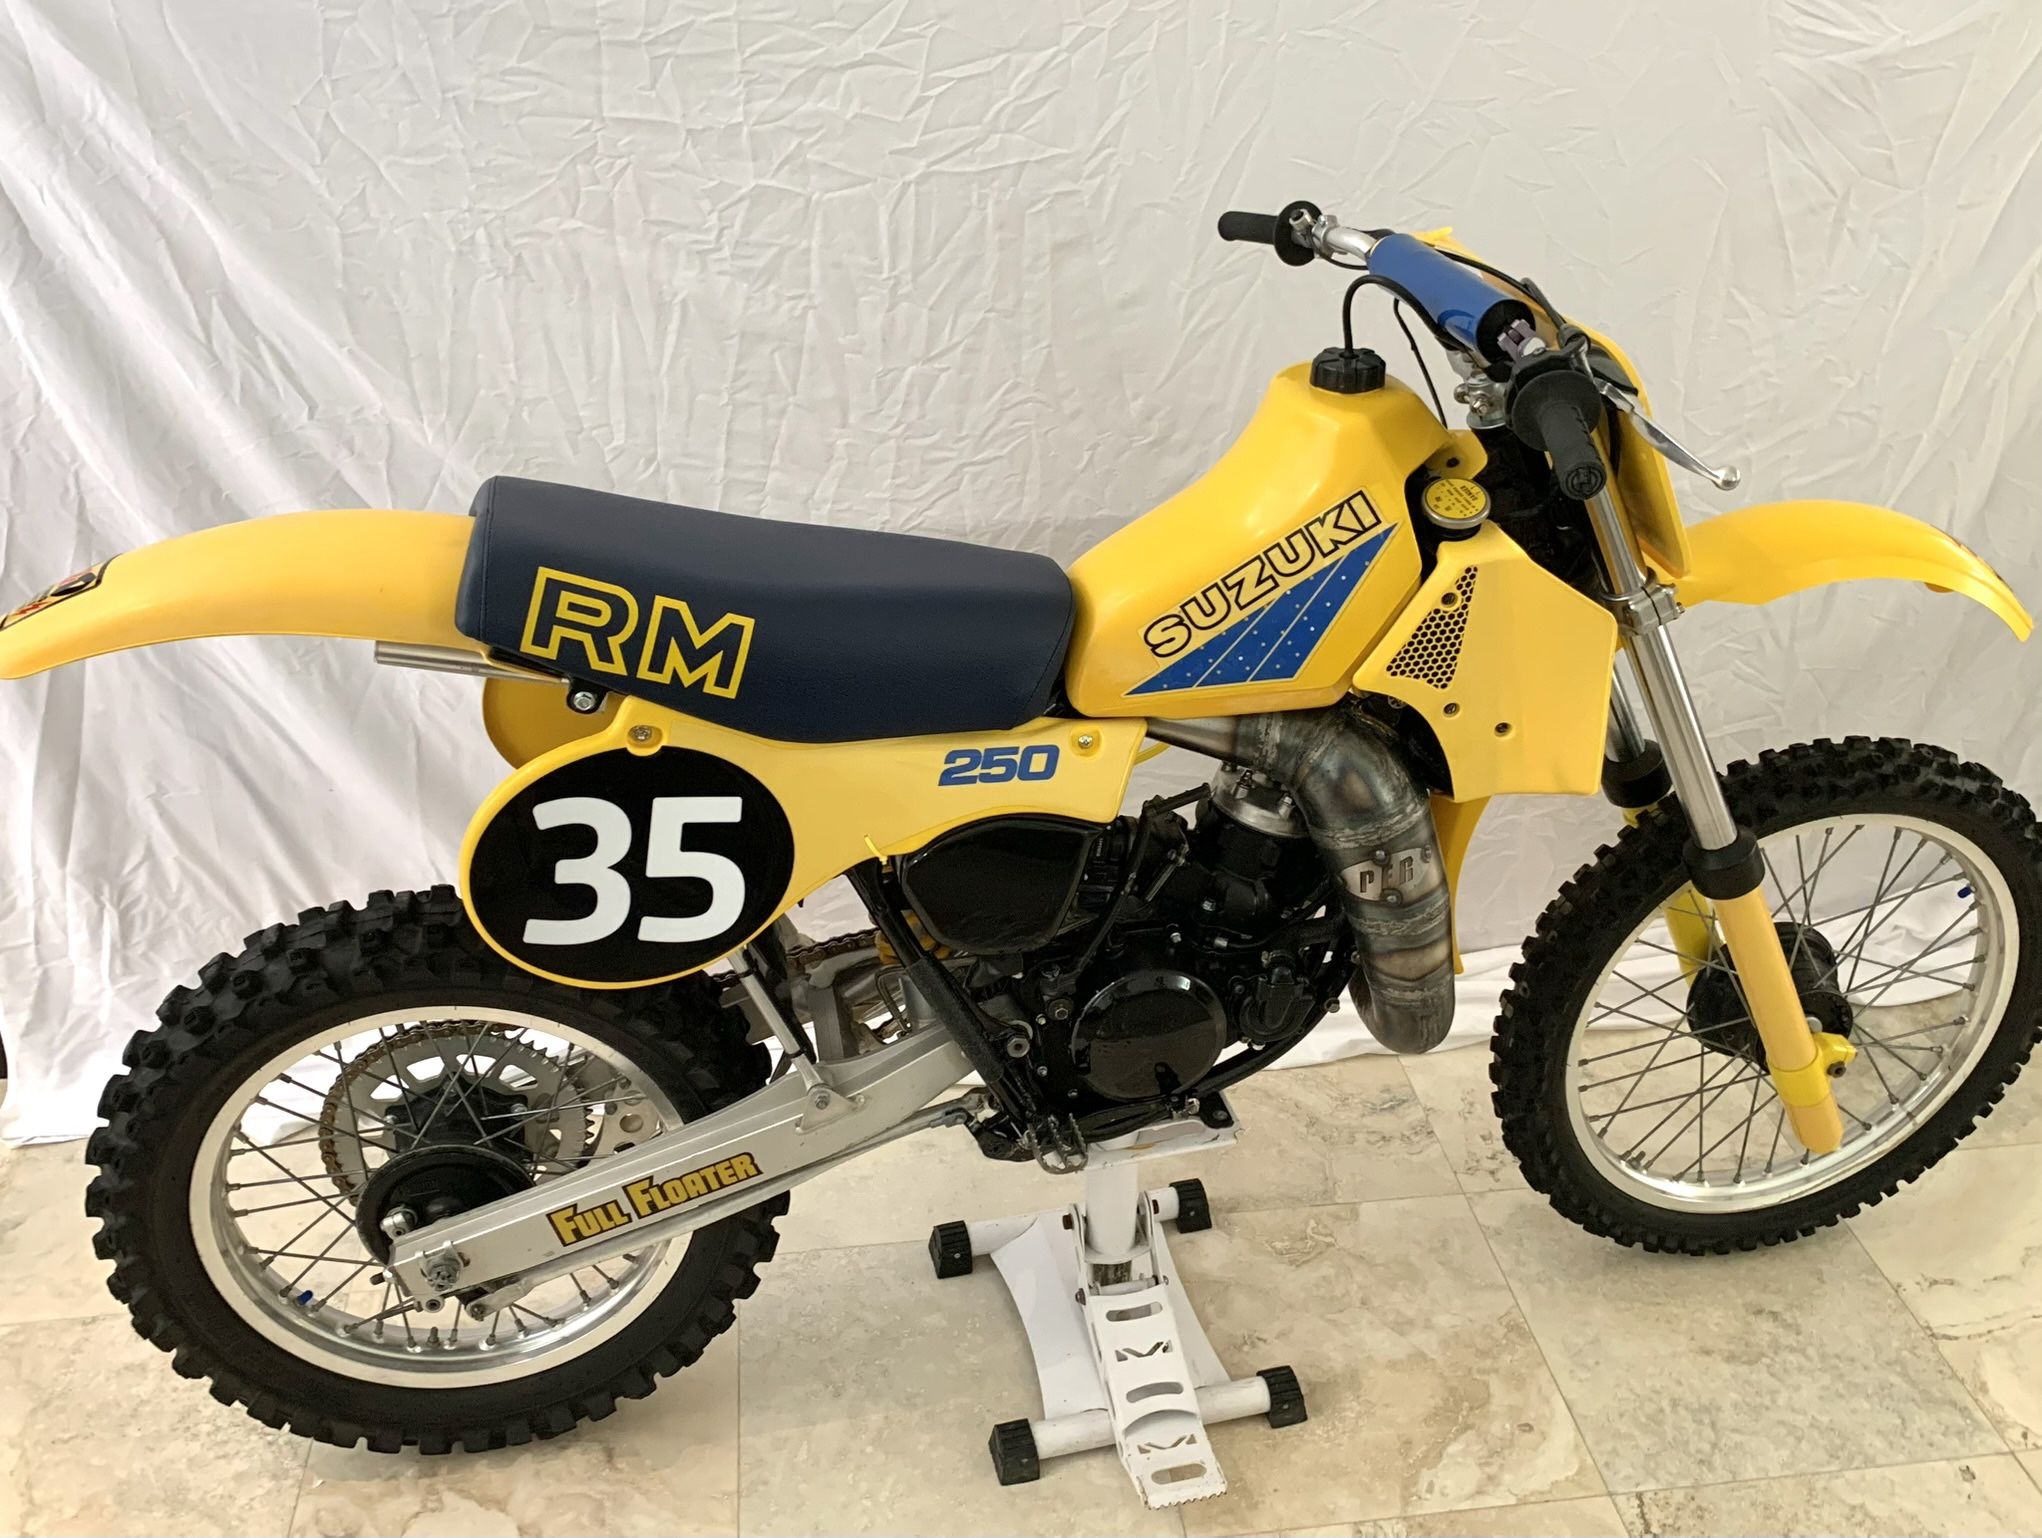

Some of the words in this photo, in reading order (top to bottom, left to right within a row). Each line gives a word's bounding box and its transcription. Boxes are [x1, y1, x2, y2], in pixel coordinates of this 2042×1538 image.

[520, 566, 756, 699] RM
[1144, 489, 1382, 657] SUZUKI
[938, 744, 1060, 787] 250
[523, 796, 746, 945] 35
[546, 1203, 633, 1247] FULL
[622, 1152, 764, 1219] FLOATER
